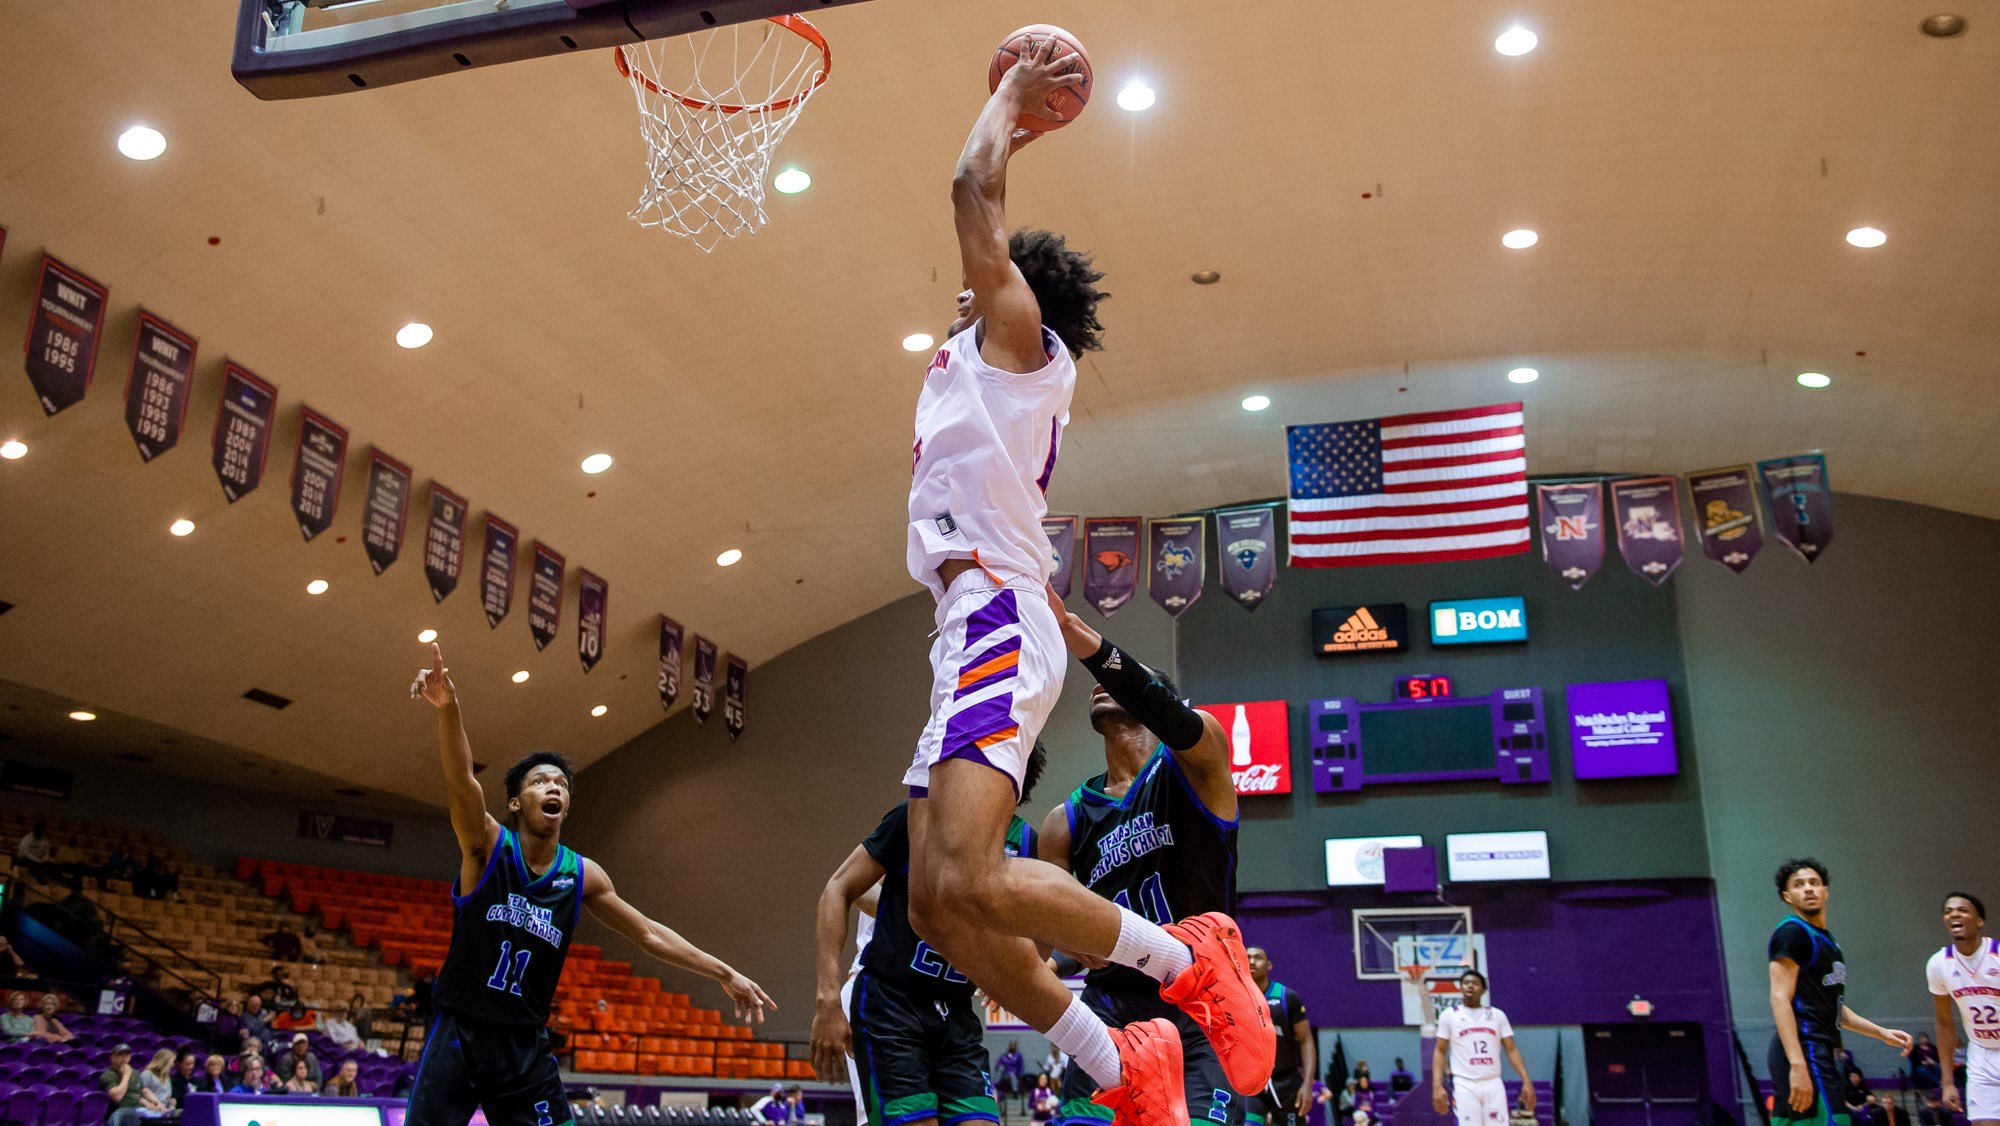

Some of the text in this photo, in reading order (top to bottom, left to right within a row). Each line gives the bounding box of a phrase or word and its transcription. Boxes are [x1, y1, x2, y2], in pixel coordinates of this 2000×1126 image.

[47, 330, 78, 357] 1986
[44, 346, 75, 373] 1995
[146, 371, 175, 396] 1986
[143, 387, 170, 411] 1993
[141, 402, 168, 426] 1995
[137, 418, 166, 442] 1999
[1459, 609, 1522, 631] BOM
[580, 631, 598, 657] 10
[1333, 628, 1388, 643] adidas
[659, 672, 676, 696] 25
[1408, 677, 1449, 699] 5:17
[694, 688, 710, 712] 33
[726, 705, 743, 728] 45
[1097, 821, 1131, 856] TEXAS
[486, 904, 563, 949] CORPUS CHRISTI
[530, 904, 552, 925] A&M
[487, 940, 531, 996] 11
[1968, 1005, 1999, 1025] 22
[1473, 1040, 1488, 1054] 12
